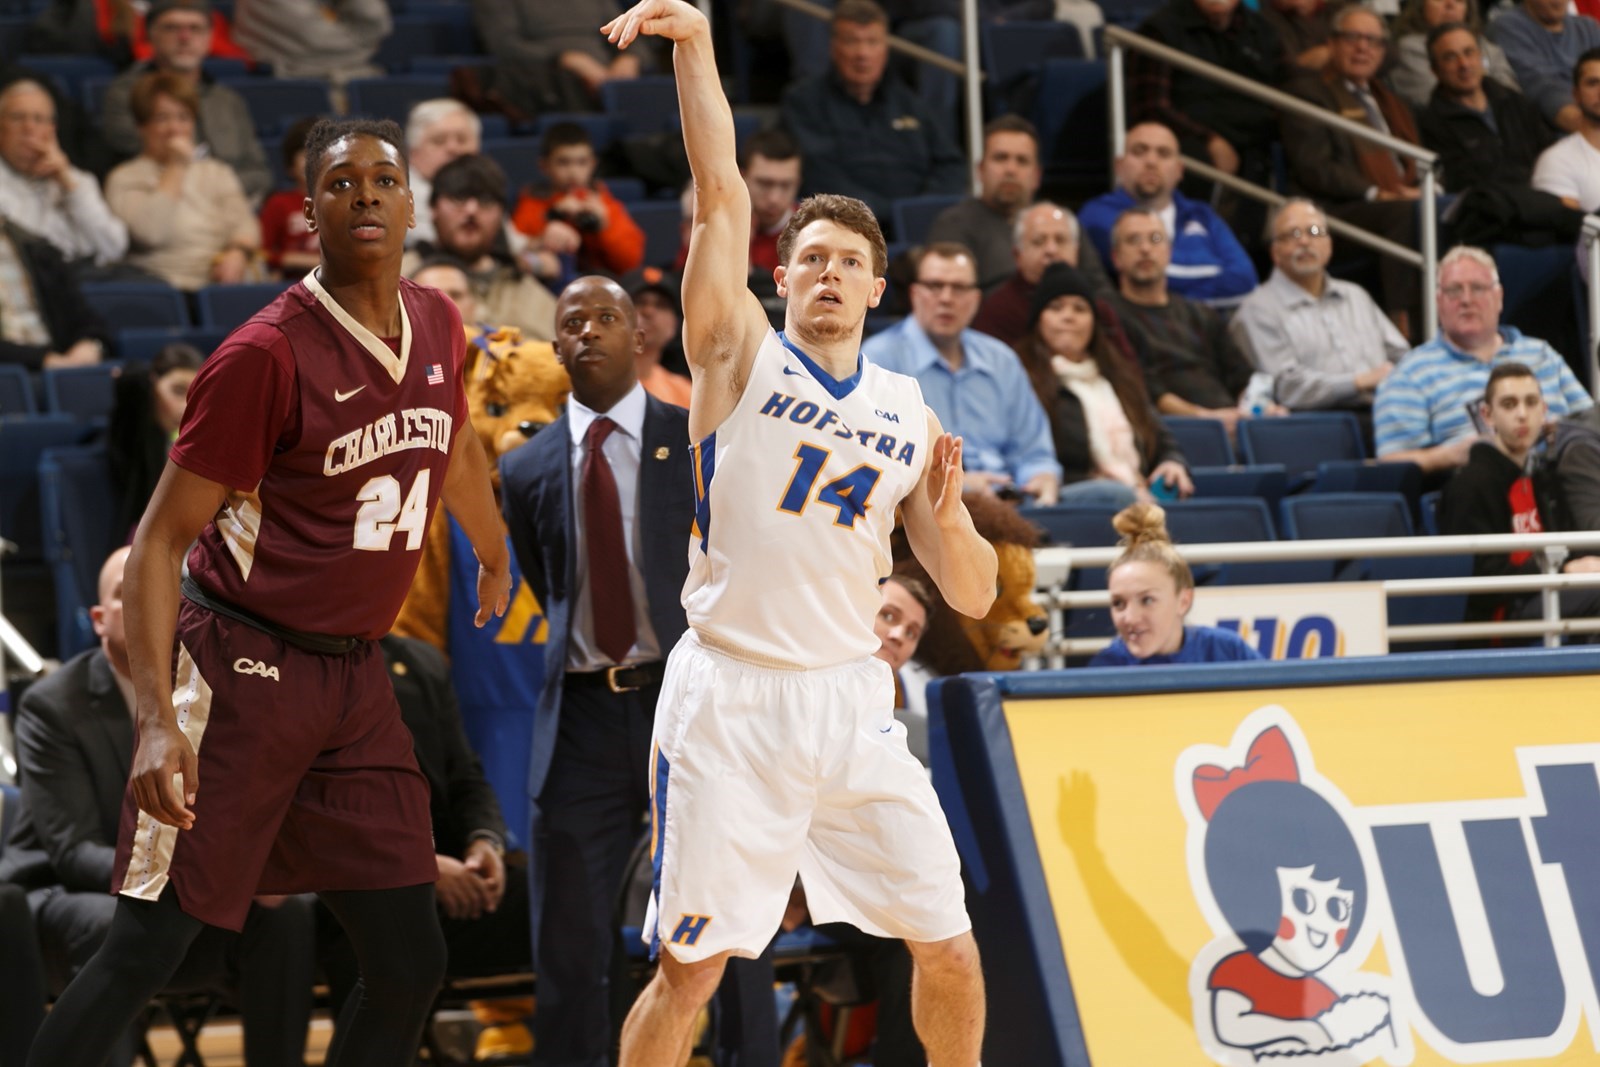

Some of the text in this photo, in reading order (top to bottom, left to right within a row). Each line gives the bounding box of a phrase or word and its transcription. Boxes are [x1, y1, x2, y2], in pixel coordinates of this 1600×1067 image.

[874, 409, 900, 424] CAA
[323, 407, 453, 477] CHARLESTO
[776, 440, 884, 531] 14
[353, 468, 431, 551] 24
[1216, 614, 1345, 661] 10
[233, 657, 280, 682] CAA
[667, 912, 713, 947] H
